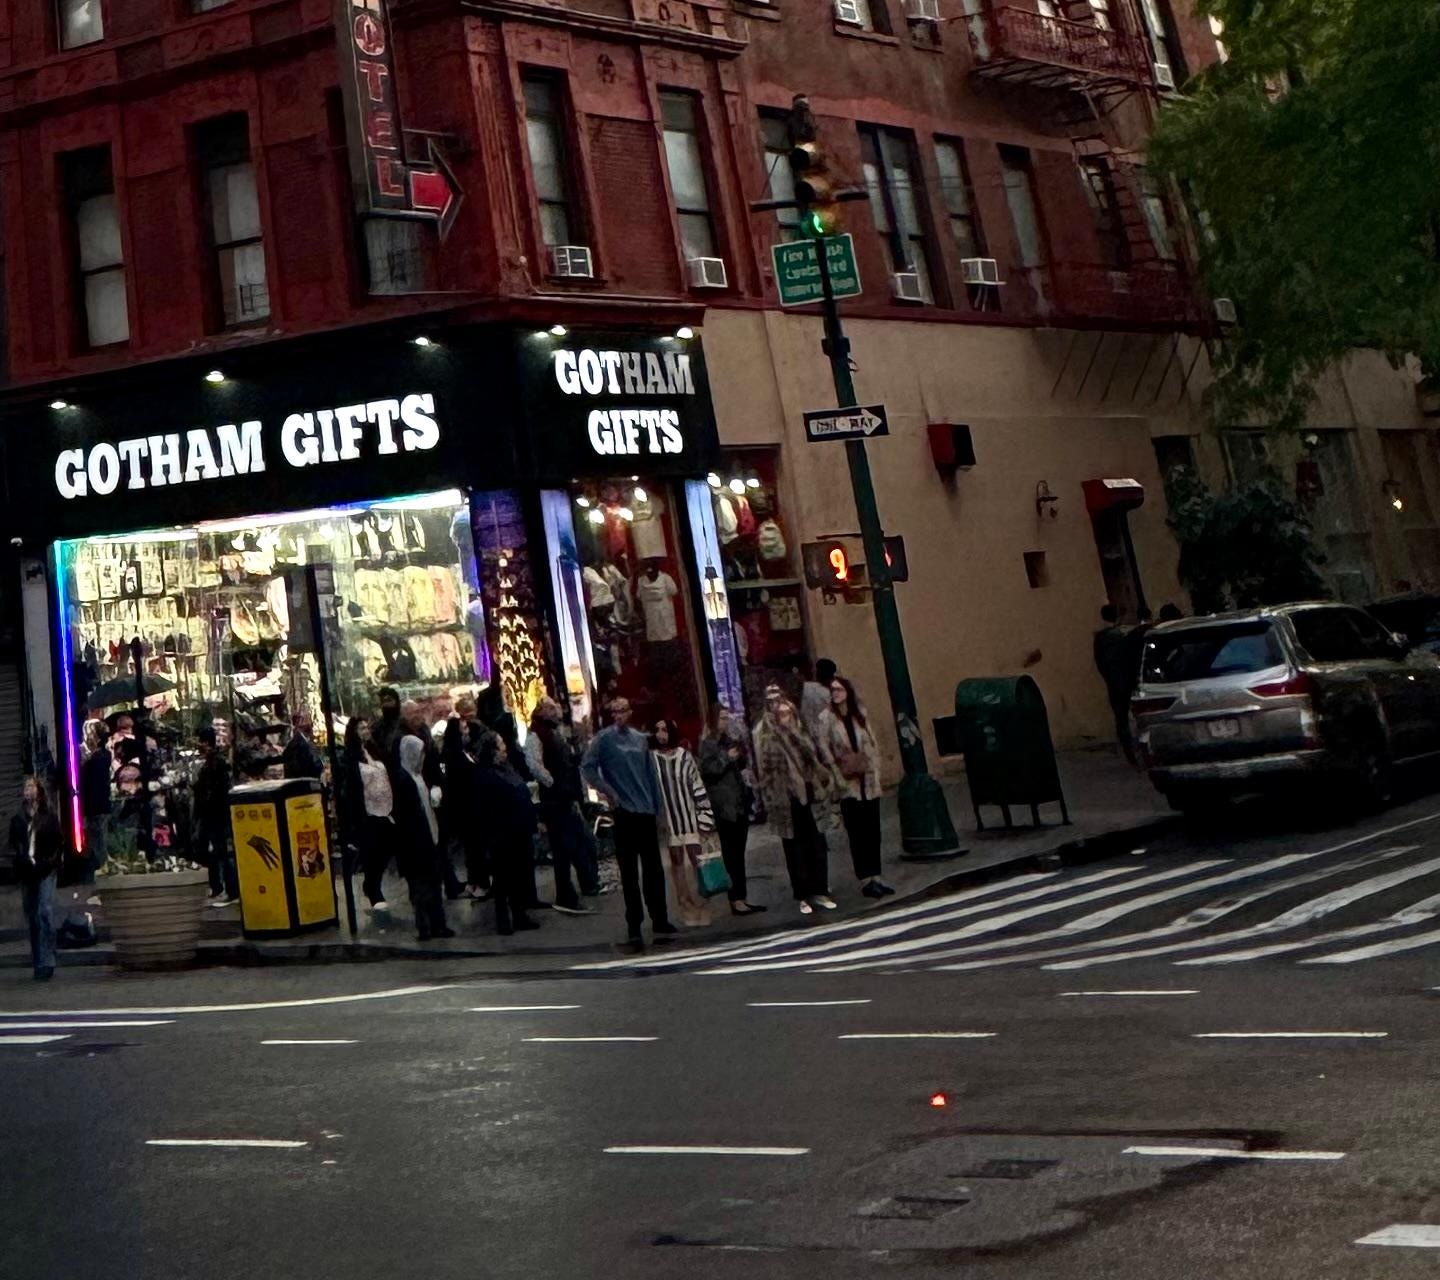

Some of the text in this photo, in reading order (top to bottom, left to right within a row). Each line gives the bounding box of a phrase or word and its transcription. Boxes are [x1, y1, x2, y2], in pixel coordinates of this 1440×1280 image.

[554, 349, 696, 395] GOTHAM
[55, 393, 440, 499] GOTHAM GIFTS
[587, 409, 684, 455] GIFTS
